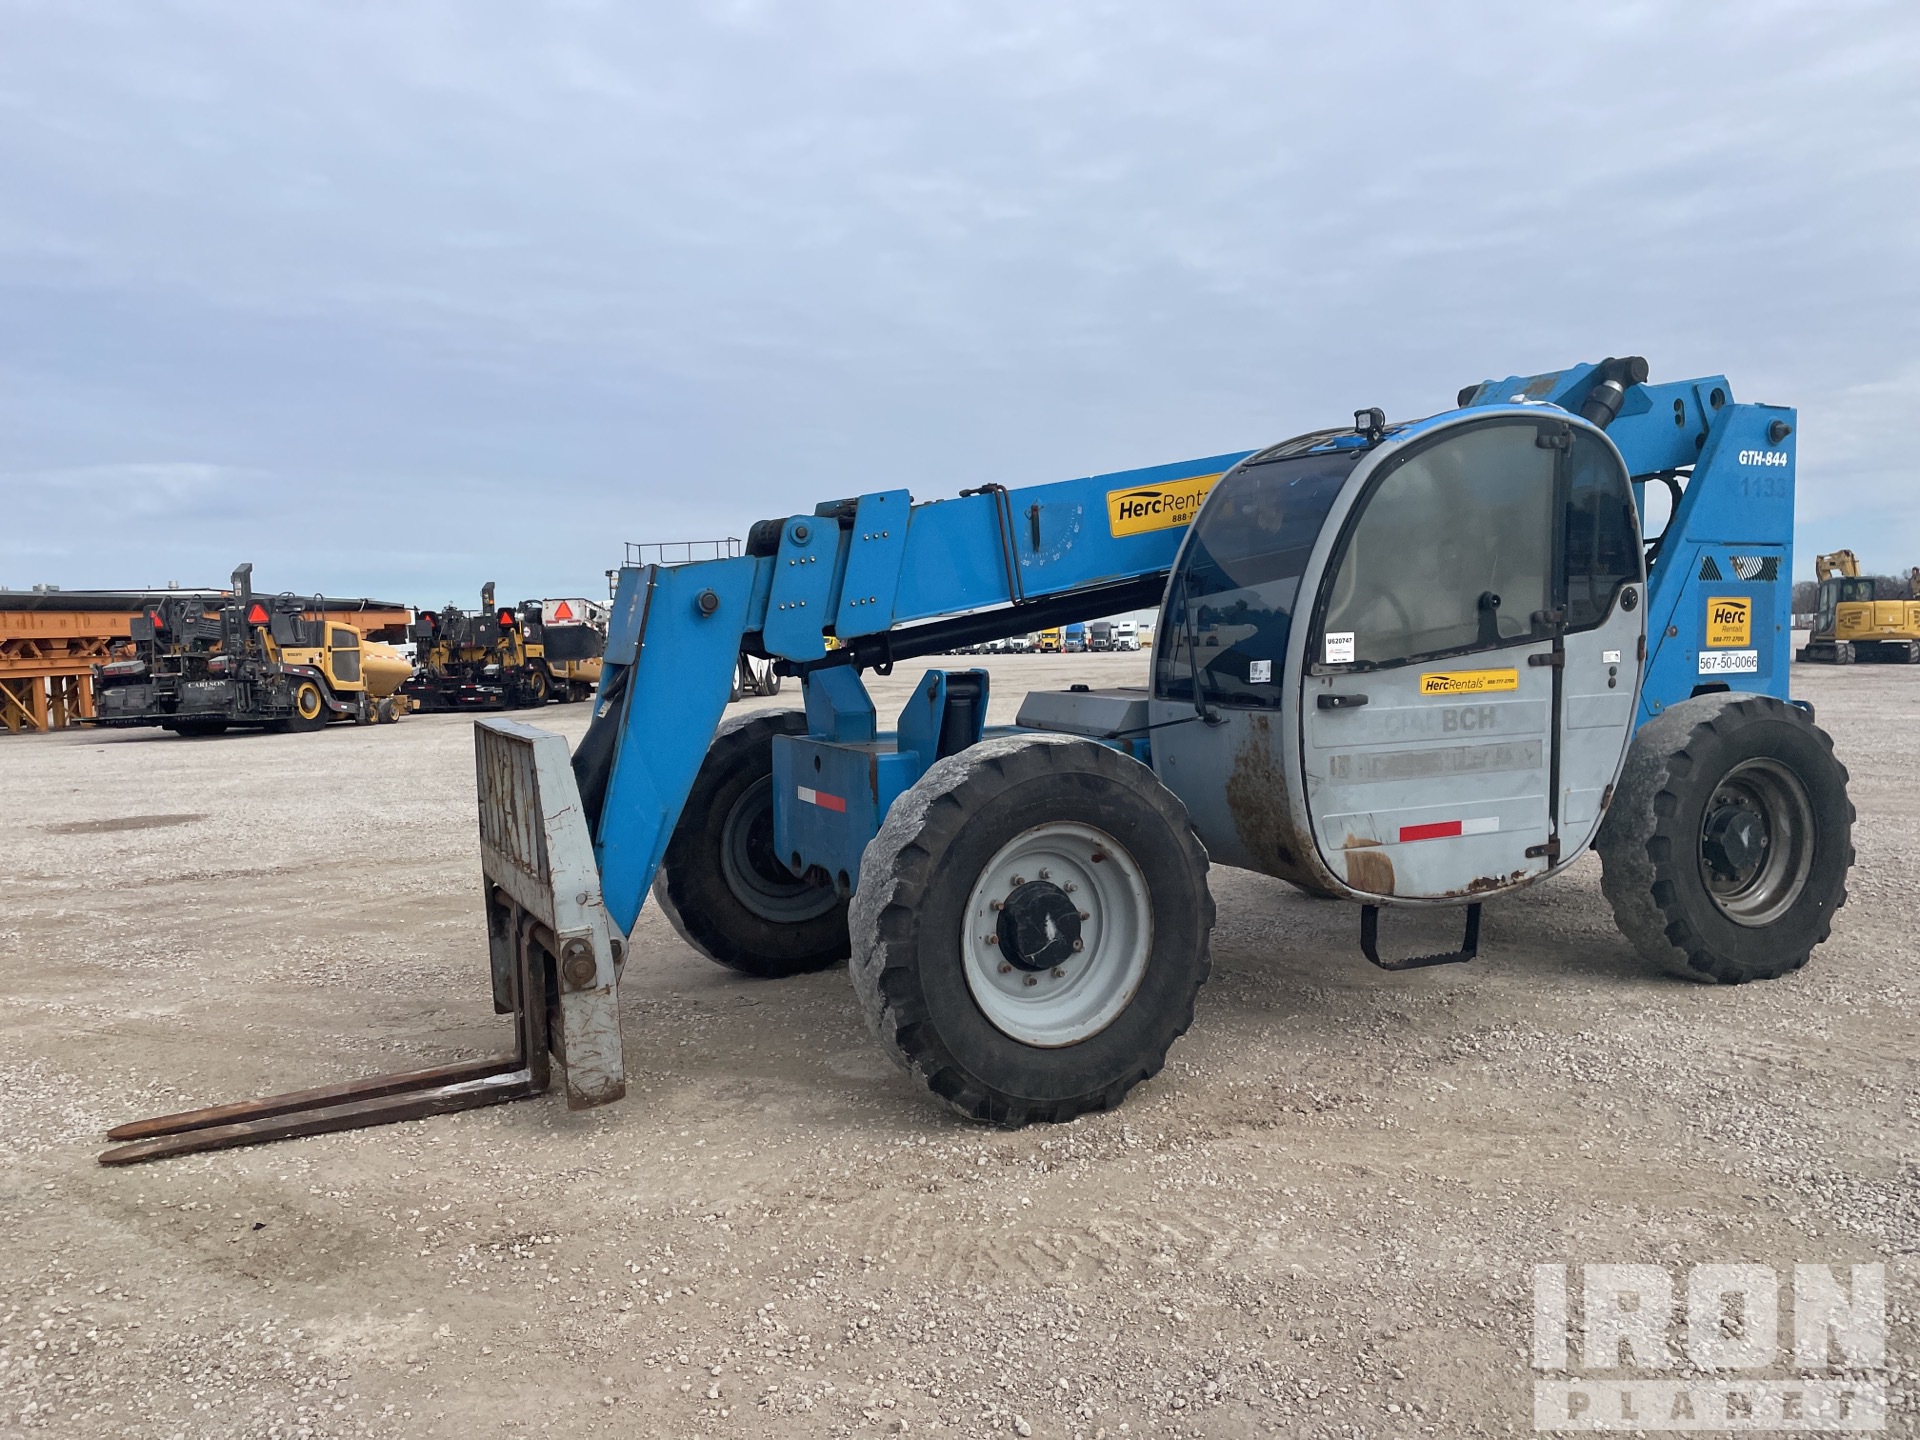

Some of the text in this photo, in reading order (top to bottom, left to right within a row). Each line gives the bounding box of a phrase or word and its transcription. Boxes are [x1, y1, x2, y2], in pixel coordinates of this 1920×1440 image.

[1739, 450, 1788, 467] GTH-844
[1713, 608, 1746, 624] Herc
[1721, 625, 1744, 633] Rentals
[1700, 655, 1757, 670] 567-50-0066
[1442, 705, 1496, 733] BCH
